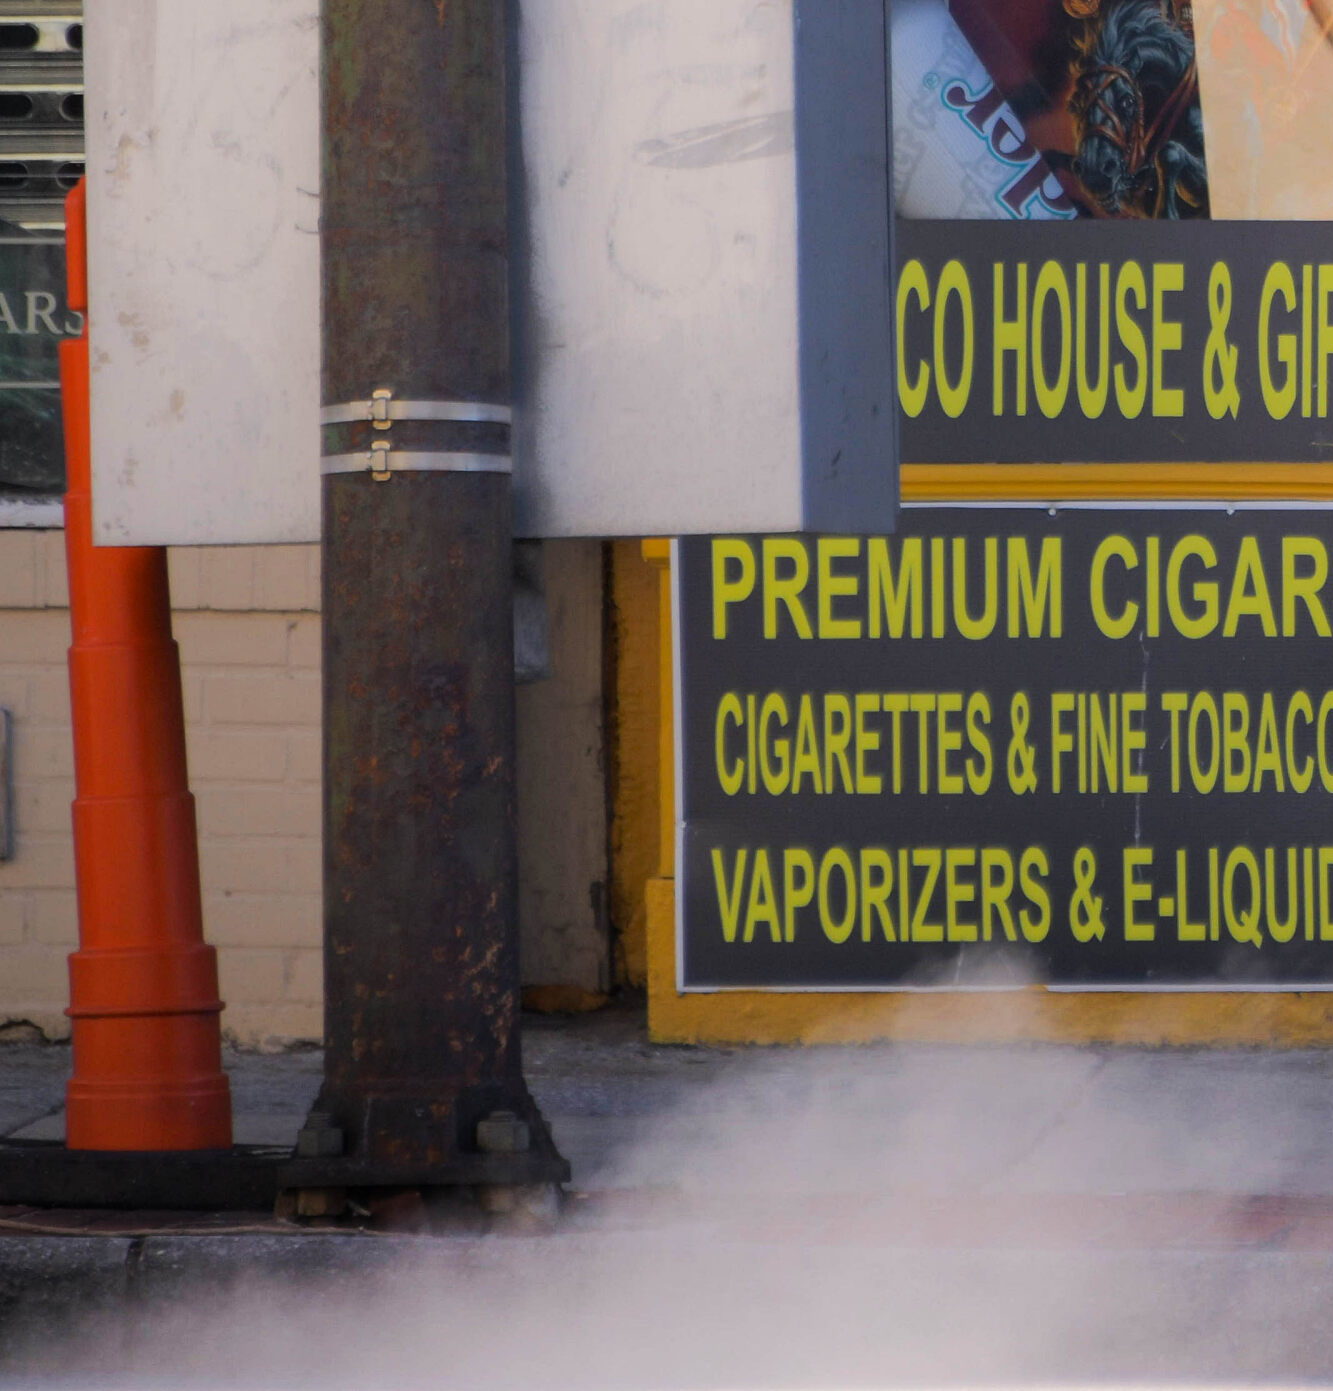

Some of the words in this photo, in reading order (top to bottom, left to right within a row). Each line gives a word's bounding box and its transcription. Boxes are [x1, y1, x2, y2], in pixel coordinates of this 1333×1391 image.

[993, 259, 1184, 420] HOUSE
[1203, 261, 1241, 421] &
[712, 537, 1062, 641] PREMIUM
[715, 692, 993, 797] CIGARETTES
[1008, 691, 1037, 796] &
[1051, 693, 1149, 795] FINE
[711, 847, 1051, 943] VAPORIZERS
[1069, 847, 1105, 943] &
